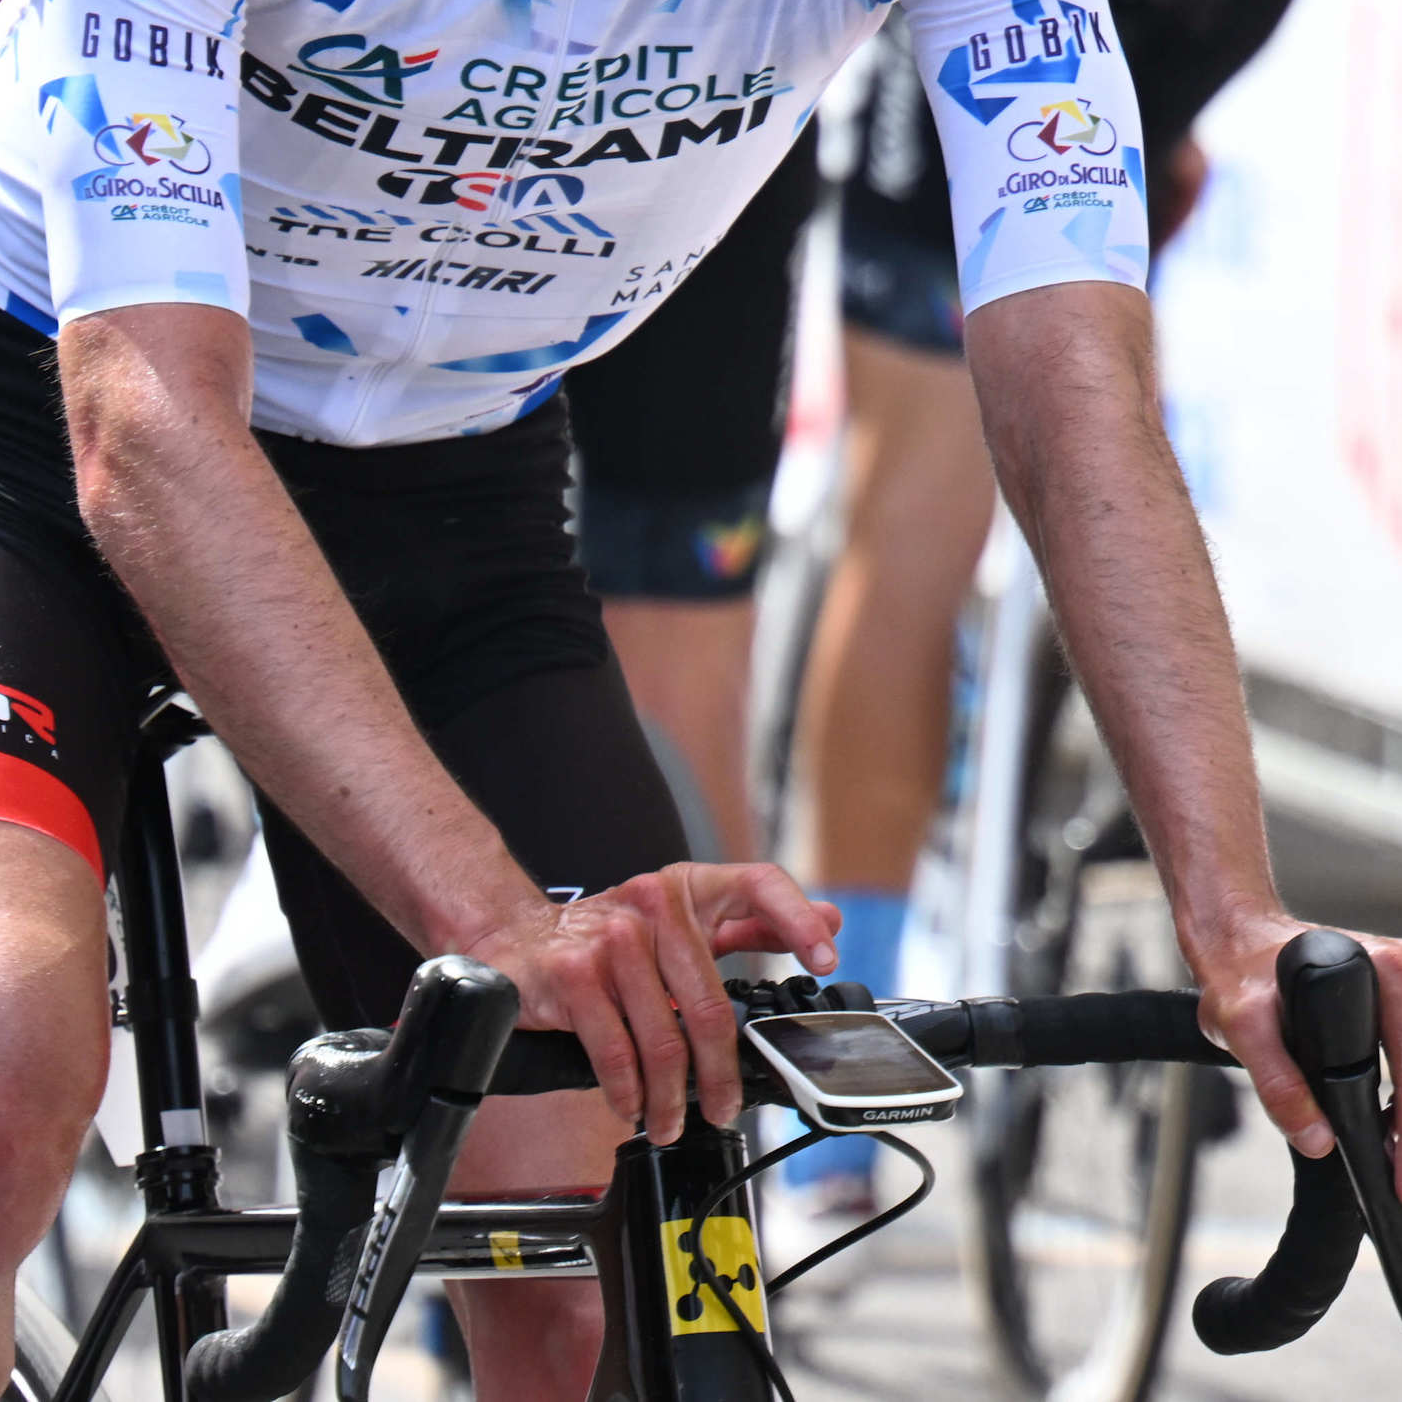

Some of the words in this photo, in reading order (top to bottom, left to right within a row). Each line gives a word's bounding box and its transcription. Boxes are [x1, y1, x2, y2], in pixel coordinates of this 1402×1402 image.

[82, 12, 225, 80] GOBIK
[969, 10, 1112, 72] GOBIK
[443, 66, 776, 131] AGRICOLE
[460, 45, 694, 102] CRÉDIT
[240, 50, 774, 170] BELTRAMI
[158, 177, 225, 210] SICILIA
[1070, 162, 1128, 188] SICILIA
[419, 224, 617, 258] COLLI
[862, 1106, 934, 1121] GARMIN
